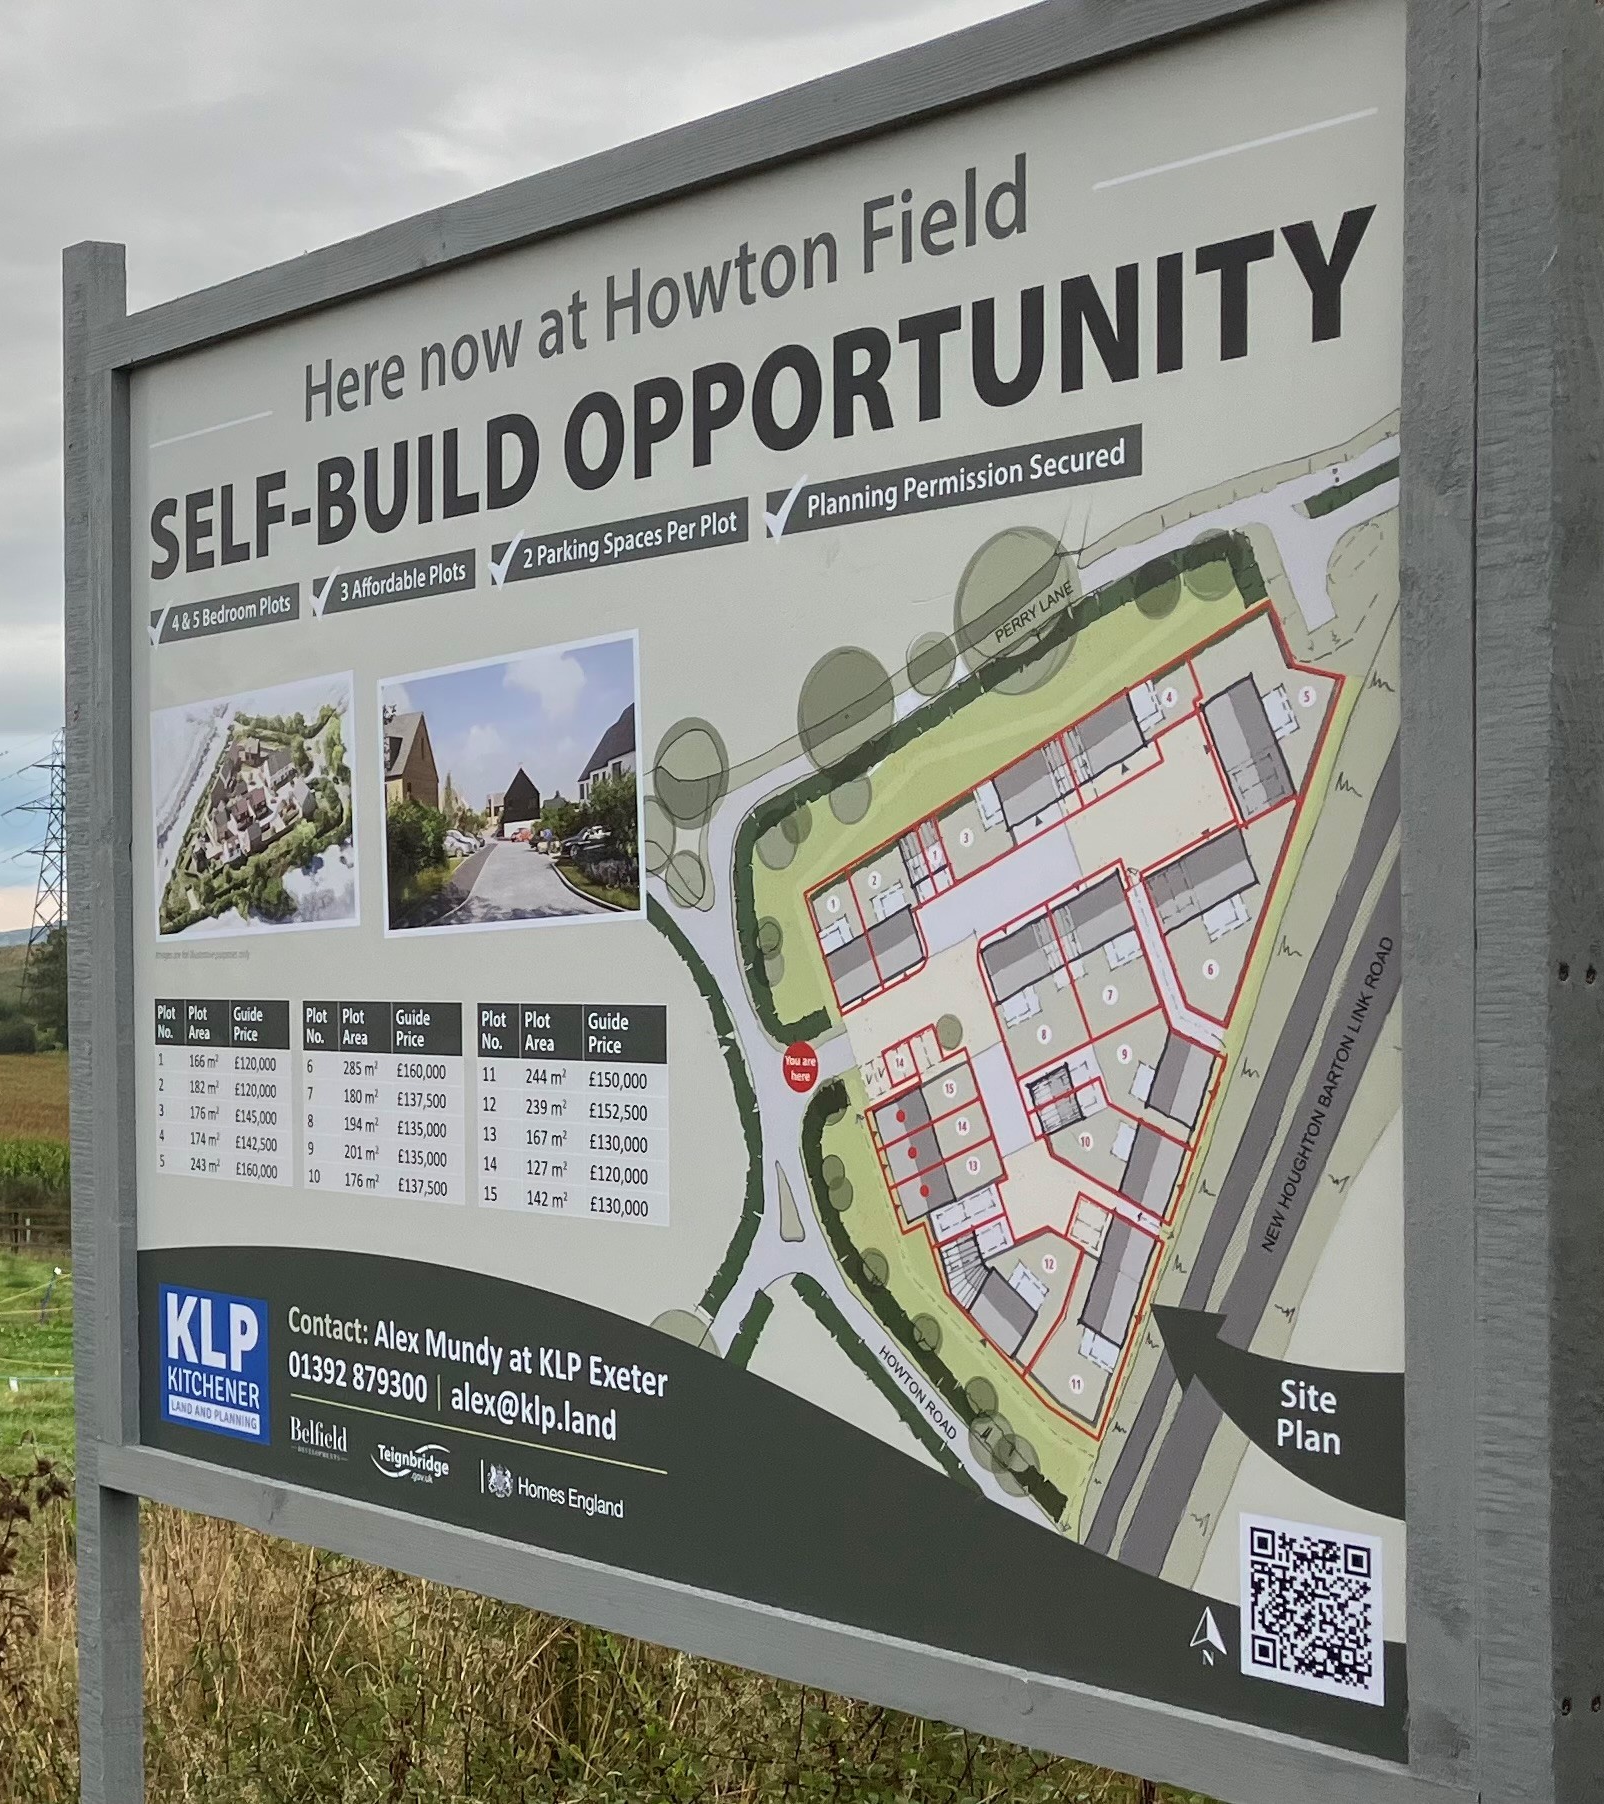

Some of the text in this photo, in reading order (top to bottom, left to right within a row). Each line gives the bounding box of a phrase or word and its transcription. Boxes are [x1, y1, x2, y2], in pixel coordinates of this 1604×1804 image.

[305, 153, 1027, 422] Here now at Howton Field
[150, 203, 1376, 580] SELF-BUILD OPPORTUNITY
[808, 438, 1125, 519] Planning Permission Secured
[523, 511, 737, 569] 2 Parking Spaces Per Plot
[340, 563, 466, 601] 3 Affordable Plots
[172, 596, 291, 631] 4 & 5 Bedroom Plots
[995, 578, 1073, 643] PERRY LANE
[1166, 692, 1172, 701] 4
[1304, 691, 1310, 702] 5
[964, 833, 969, 843] 3
[872, 876, 877, 886] 2
[1208, 964, 1214, 976] 6
[1107, 989, 1113, 1001] 7
[158, 1005, 175, 1020] Plot
[188, 1006, 207, 1021] Plot
[233, 1007, 263, 1022] Guide
[306, 1007, 327, 1024] Plot
[343, 1008, 364, 1024] Plot
[396, 1009, 430, 1026] Guide
[482, 1011, 506, 1028] Plot
[525, 1011, 550, 1028] Plot
[588, 1013, 629, 1030] Guide
[158, 1025, 173, 1039] No.
[188, 1026, 210, 1040] Area
[233, 1027, 258, 1042] Price
[306, 1029, 324, 1044] No.
[343, 1030, 368, 1045] Area
[396, 1031, 424, 1047] Price
[1041, 1029, 1046, 1040] 8
[482, 1033, 502, 1050] No.
[525, 1035, 554, 1051] Area
[588, 1036, 621, 1053] Price
[785, 1055, 816, 1067] You are
[1122, 1048, 1127, 1060] 9
[159, 1053, 164, 1066] 1
[190, 1055, 205, 1068] 166
[235, 1056, 276, 1073] £120,000
[307, 1059, 313, 1073] 6
[343, 1061, 362, 1075] 285
[397, 1063, 446, 1081] £160,000
[896, 1058, 904, 1068] 14
[483, 1066, 496, 1082] 11
[525, 1068, 547, 1085] 244
[589, 1072, 647, 1090] £150,000
[791, 1071, 810, 1081] here
[159, 1078, 164, 1091] 2
[190, 1080, 205, 1094] 182
[235, 1082, 277, 1099] £120,000
[945, 1083, 954, 1094] 15
[1262, 936, 1393, 1252] NEW HOUGHTON BARTON LINK ROAD
[307, 1087, 313, 1100] 7
[344, 1089, 362, 1103] 180
[397, 1092, 446, 1110] £137,500
[159, 1104, 164, 1116] 3
[190, 1106, 205, 1119] 176
[235, 1109, 277, 1126] £145,000
[483, 1096, 496, 1112] 12
[526, 1099, 547, 1115] 239
[589, 1103, 648, 1122] £152,500
[308, 1114, 314, 1128] 8
[344, 1117, 362, 1131] 194
[398, 1121, 447, 1139] £135,000
[958, 1121, 967, 1131] 14
[159, 1130, 164, 1141] 4
[190, 1132, 206, 1145] 174
[236, 1136, 277, 1153] £142,500
[483, 1126, 497, 1142] 13
[526, 1130, 547, 1146] 167
[590, 1134, 648, 1154] £130,000
[1081, 1137, 1090, 1147] 10
[308, 1142, 314, 1155] 9
[345, 1145, 362, 1160] 201
[398, 1149, 447, 1168] £135,000
[159, 1154, 165, 1167] 5
[191, 1157, 206, 1171] 243
[236, 1162, 278, 1180] £160,000
[483, 1156, 497, 1172] 14
[527, 1160, 547, 1177] 127
[590, 1165, 648, 1185] £120,000
[969, 1161, 978, 1171] 13
[309, 1169, 320, 1183] 10
[345, 1173, 363, 1187] 176
[398, 1178, 448, 1197] £137,500
[484, 1186, 497, 1201] 15
[527, 1190, 548, 1207] 142
[590, 1196, 648, 1217] £130,000
[1045, 1258, 1054, 1270] 12
[166, 1292, 259, 1373] KLP
[288, 1306, 668, 1397] Contact: Alex Mundy at KLP Exeter
[168, 1365, 260, 1409] KITCHENER
[879, 1345, 956, 1439] HOWTON ROAD
[1072, 1379, 1081, 1389] 11
[288, 1351, 616, 1441] 01392 879300 alex@klp.land
[1281, 1379, 1337, 1414] Site
[171, 1400, 257, 1430] LAND AND PLANNING
[290, 1416, 347, 1452] Belfield
[1277, 1418, 1340, 1455] Plan
[378, 1444, 449, 1477] Teignbridge
[518, 1476, 623, 1518] Homes England
[1202, 1649, 1214, 1667] N
